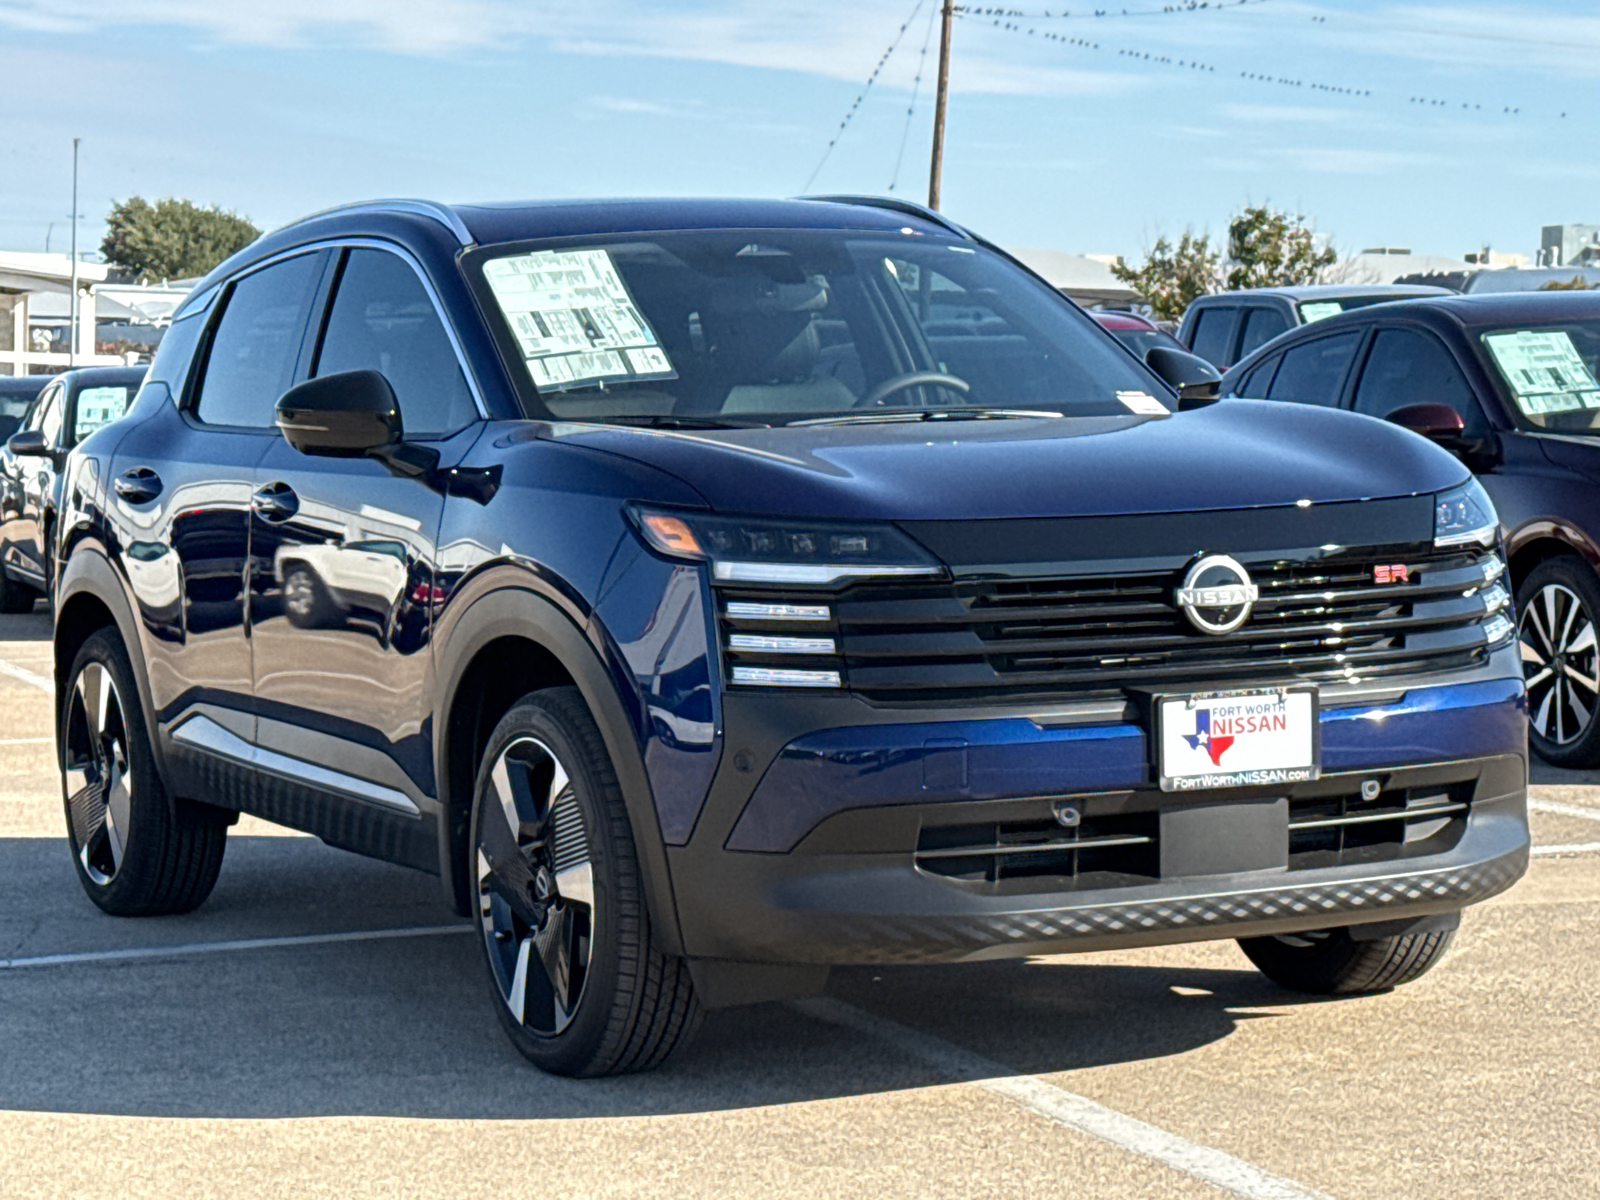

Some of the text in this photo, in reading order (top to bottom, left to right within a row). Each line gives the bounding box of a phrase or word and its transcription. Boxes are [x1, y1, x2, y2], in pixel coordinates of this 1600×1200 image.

[1374, 564, 1408, 583] SR
[1178, 587, 1258, 604] NISSAN
[1212, 703, 1286, 717] FORT WORTH
[1213, 714, 1286, 735] NISSAN
